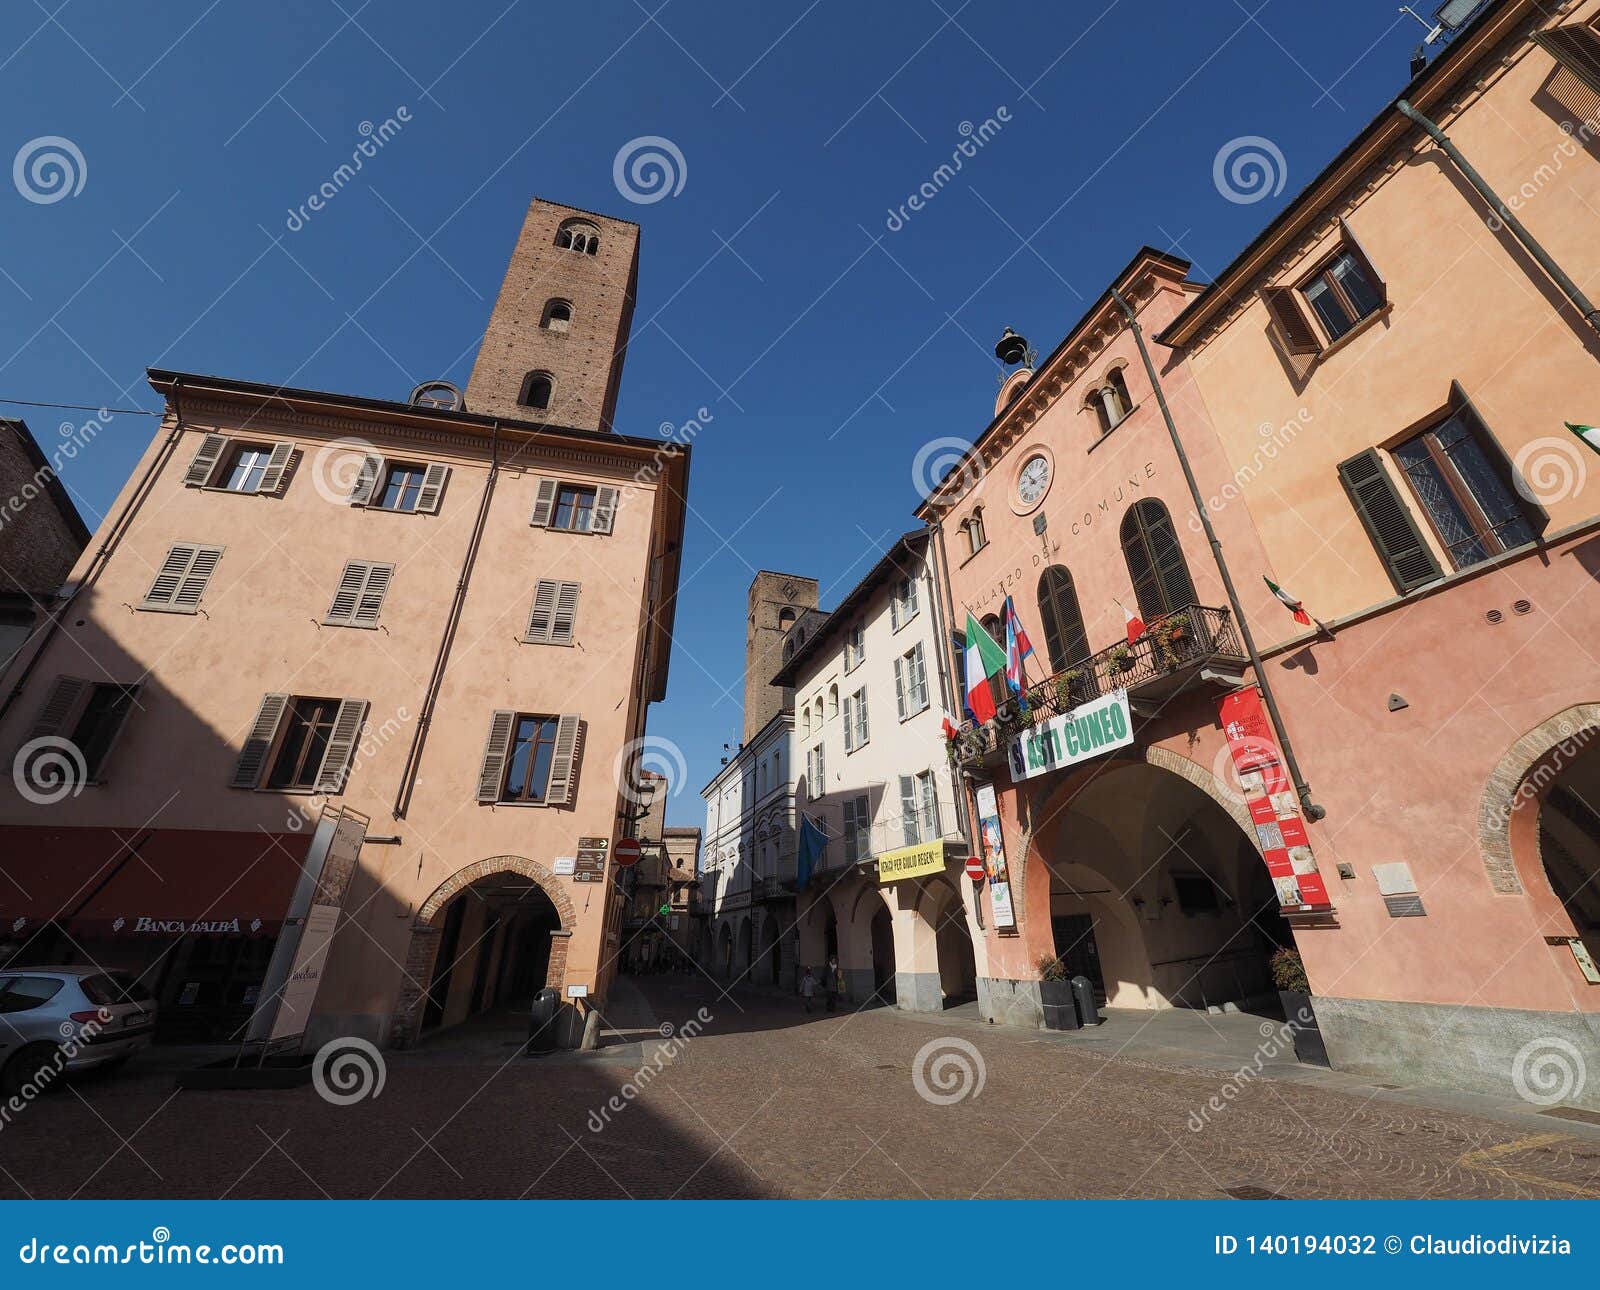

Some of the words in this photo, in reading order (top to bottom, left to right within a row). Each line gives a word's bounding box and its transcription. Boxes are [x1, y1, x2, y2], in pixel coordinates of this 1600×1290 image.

[1071, 461, 1156, 536] COMUNE
[1027, 728, 1062, 770] ASTI
[1064, 702, 1127, 757] CUNEO
[134, 917, 185, 932] BANCA
